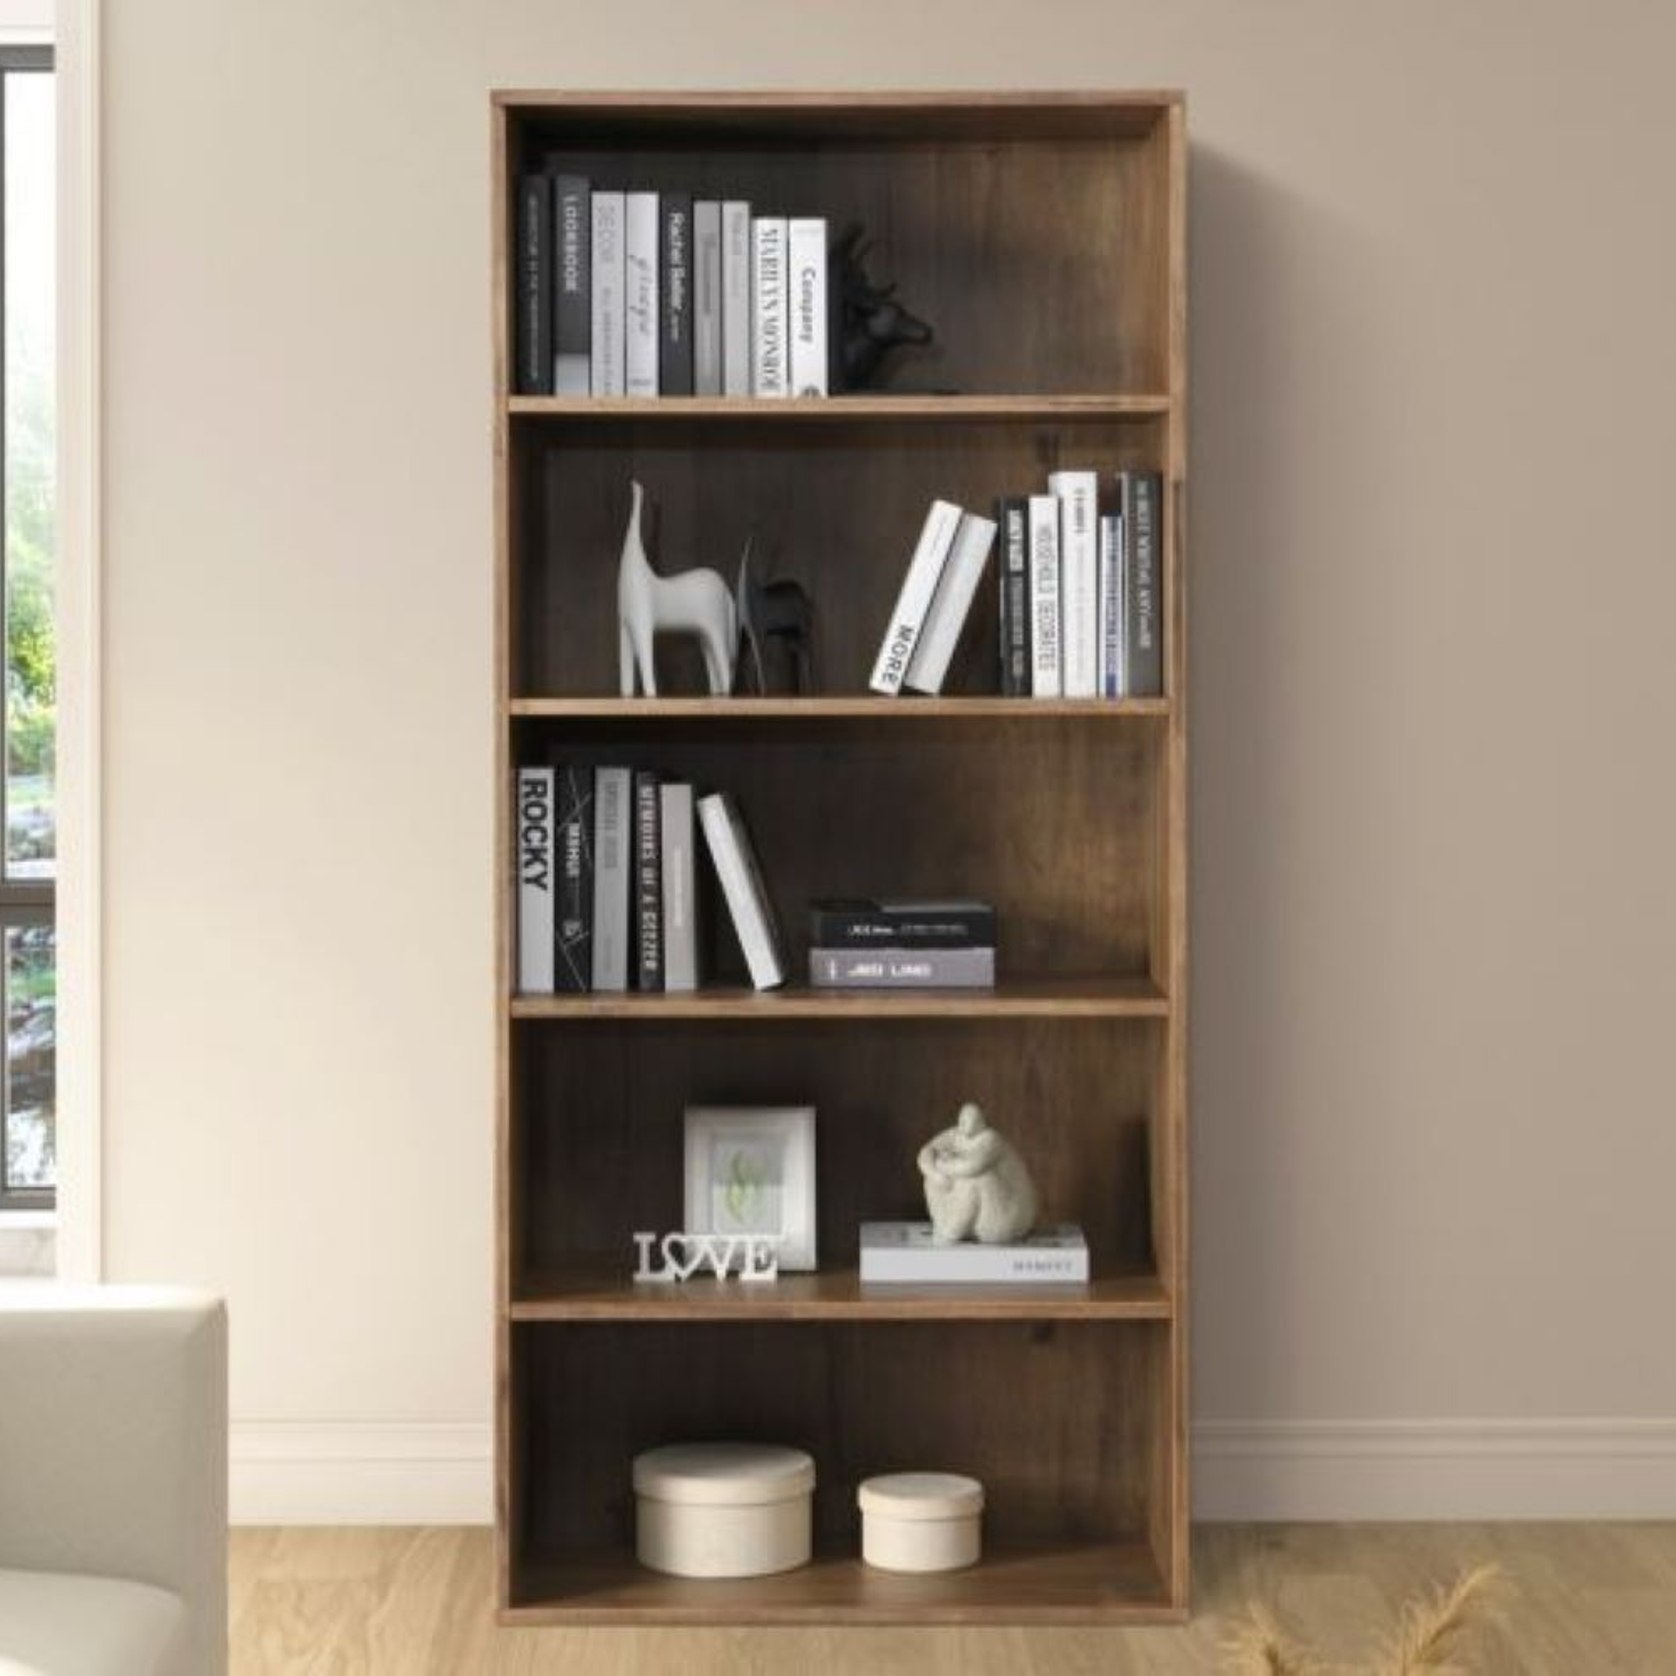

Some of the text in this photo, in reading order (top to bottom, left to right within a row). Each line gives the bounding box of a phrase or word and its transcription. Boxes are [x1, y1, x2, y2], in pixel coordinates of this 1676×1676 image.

[563, 195, 578, 293] LOOKBOOK
[760, 228, 779, 310] MARILYN
[799, 266, 816, 343] Company
[881, 624, 915, 685] MORE
[522, 777, 548, 891] ROCKY
[639, 785, 657, 860] MEMOIRS
[633, 1233, 777, 1281] LOVE
